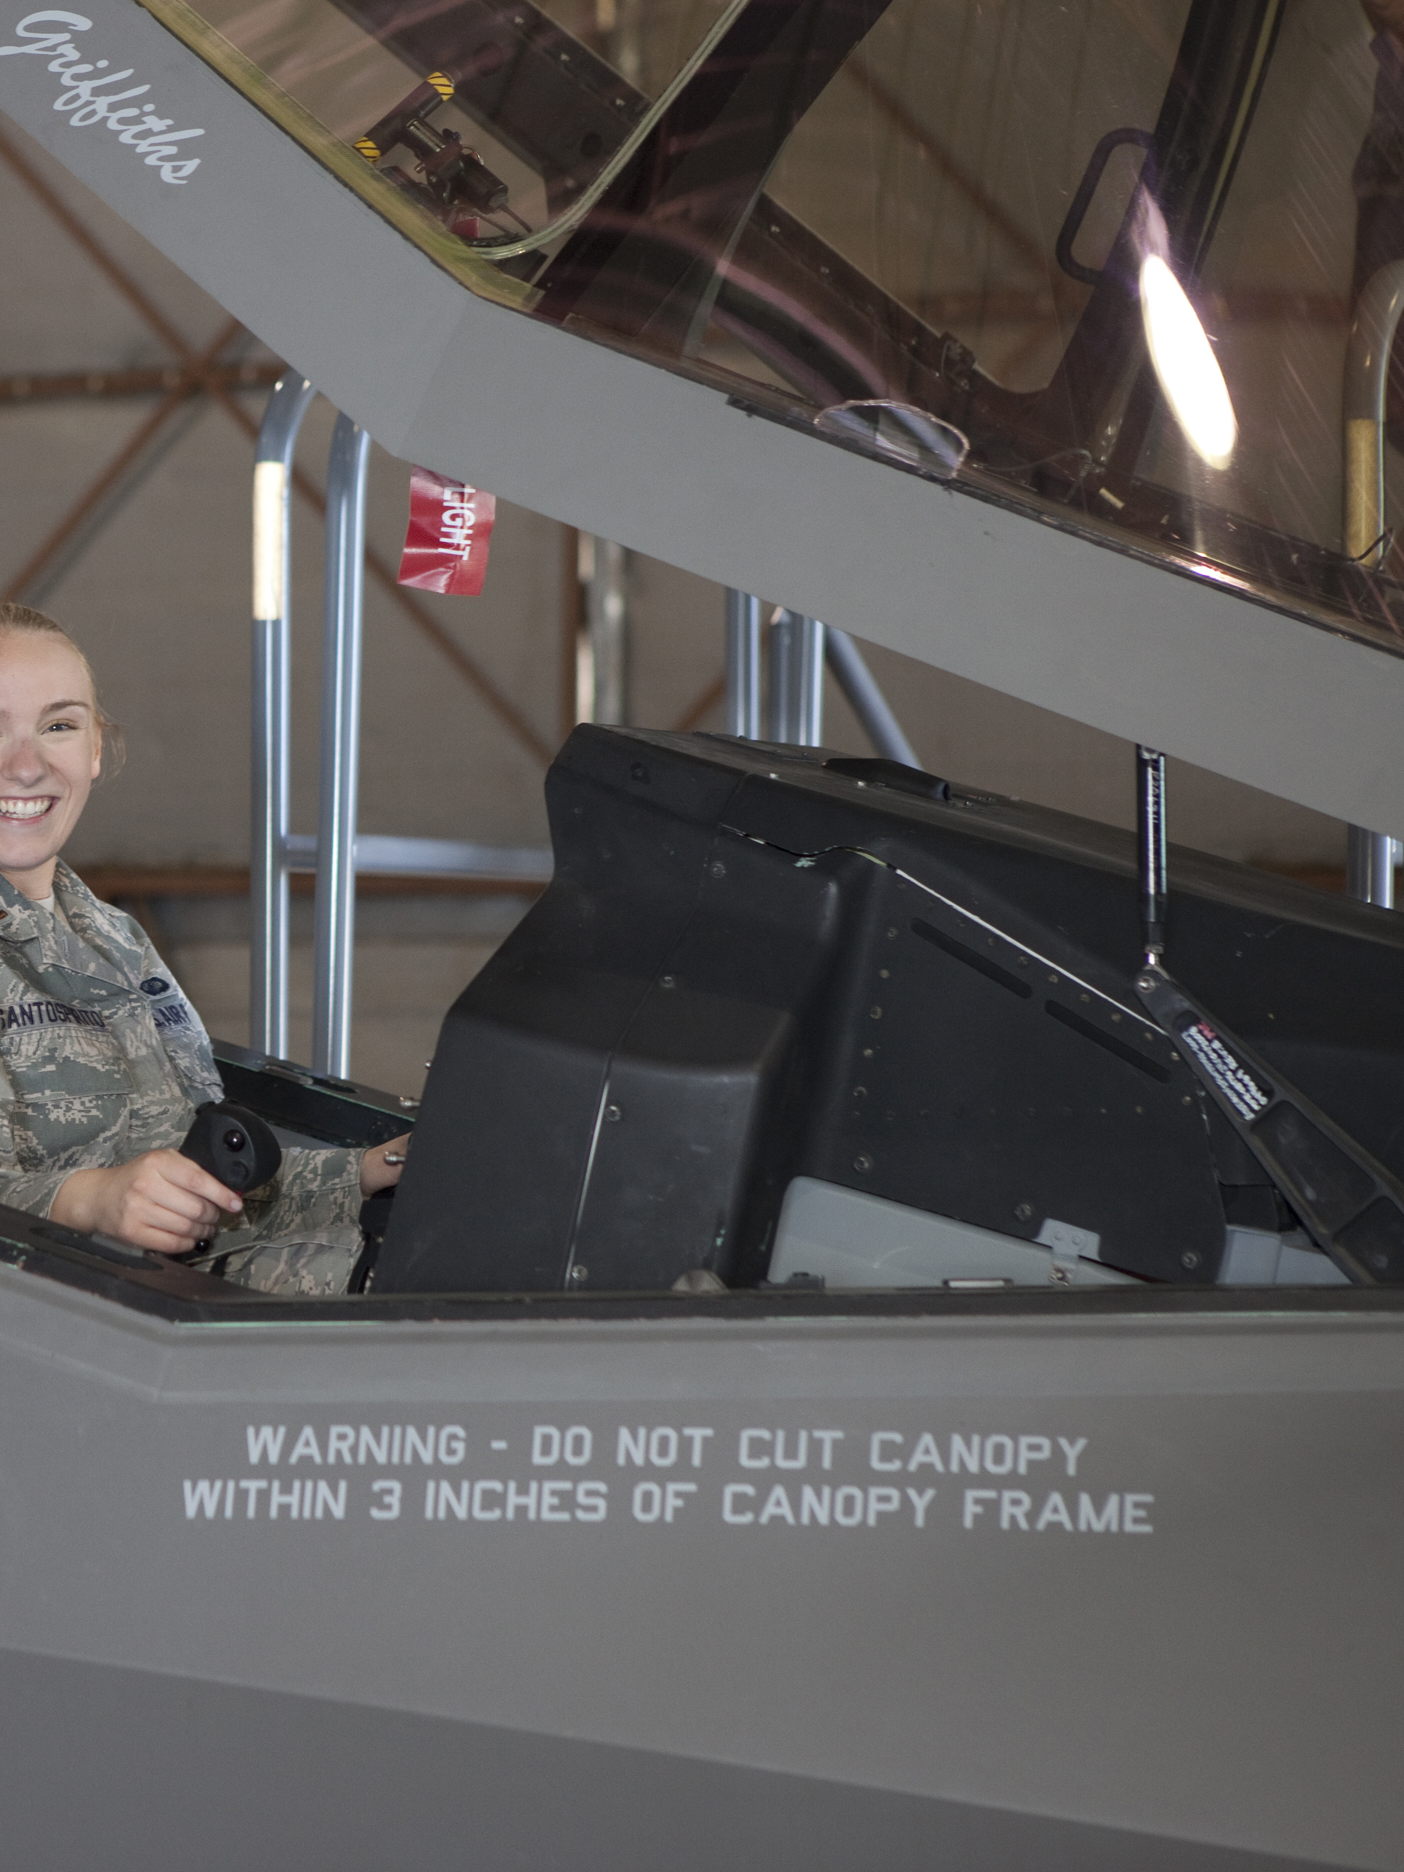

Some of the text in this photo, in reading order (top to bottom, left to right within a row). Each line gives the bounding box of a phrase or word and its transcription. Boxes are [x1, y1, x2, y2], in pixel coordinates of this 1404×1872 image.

[246, 1425, 466, 1465] WARNING
[531, 1425, 593, 1466] DO
[616, 1425, 714, 1468] NOT
[738, 1428, 845, 1470] CUT
[869, 1431, 1088, 1477] CANOPY
[183, 1479, 1155, 1533] WITHIN 3 INCHES OF CANOPY FRAME
